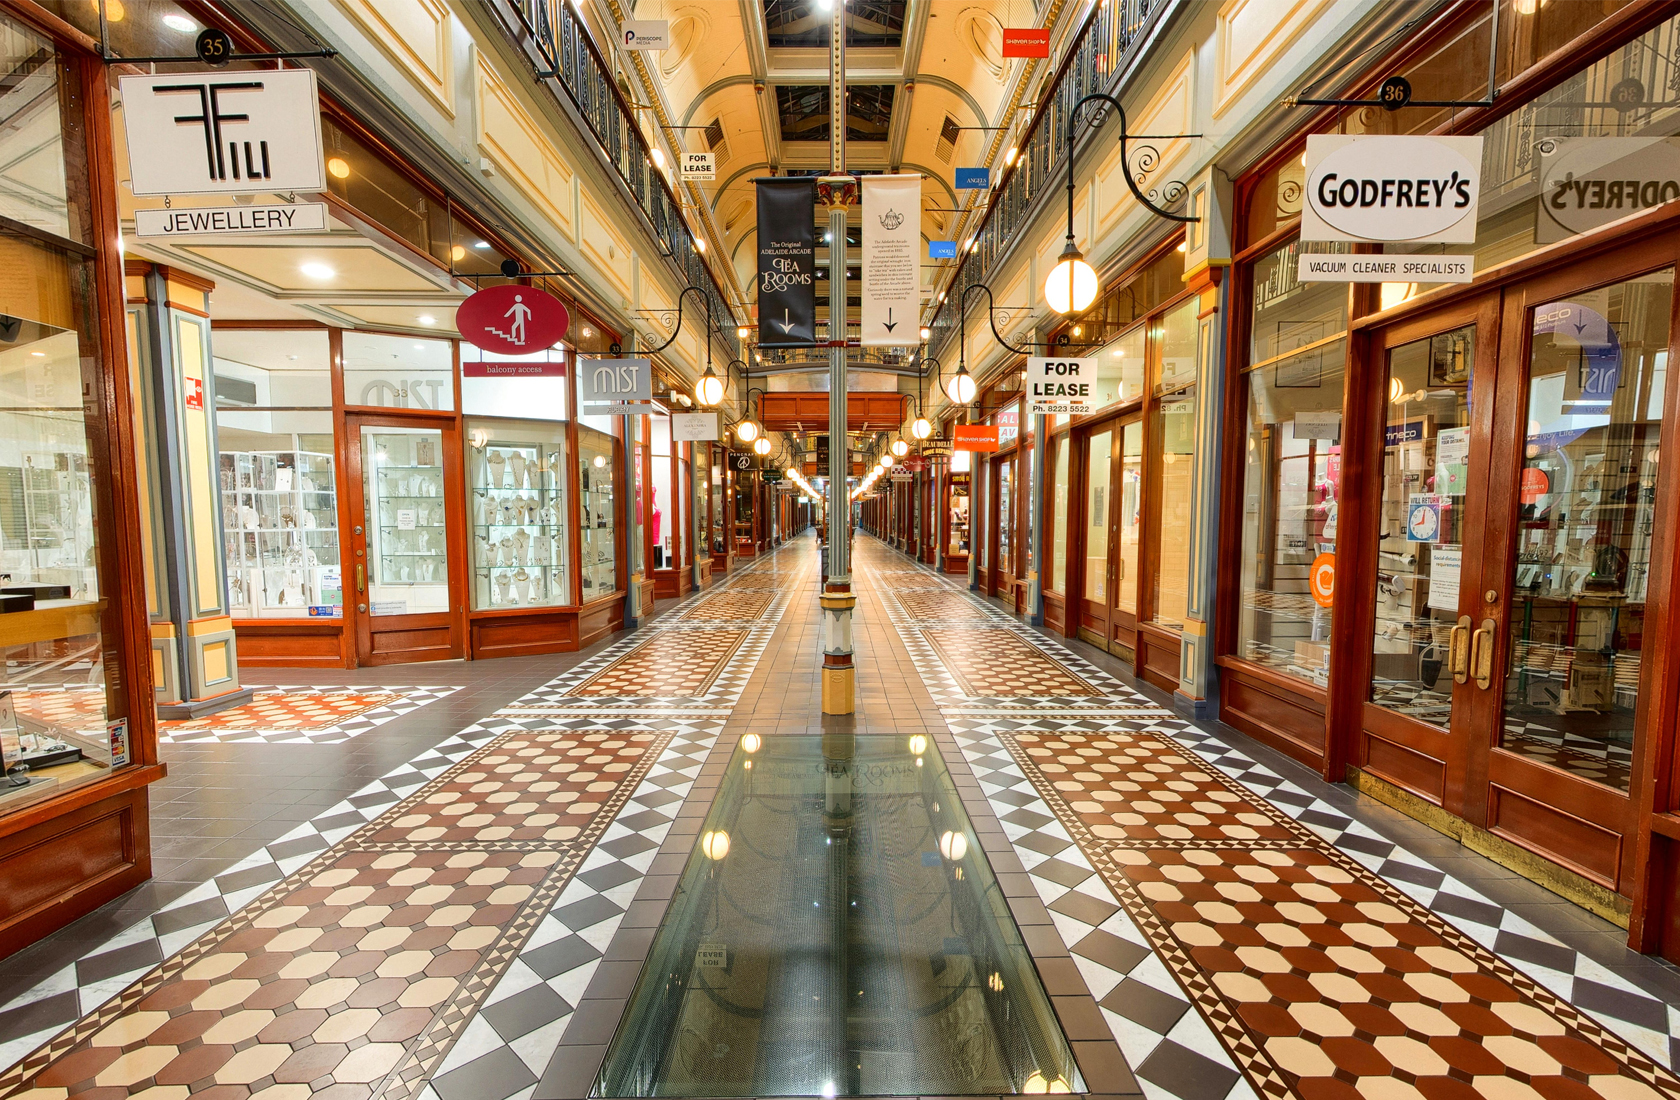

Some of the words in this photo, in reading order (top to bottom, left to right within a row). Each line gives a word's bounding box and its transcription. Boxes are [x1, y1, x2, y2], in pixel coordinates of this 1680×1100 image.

[203, 38, 223, 56] 35
[1385, 85, 1404, 101] 36
[1317, 170, 1471, 208] GODFREY'S
[163, 209, 296, 233] JEWELLERY
[781, 241, 802, 249] Original
[1309, 261, 1347, 273] VACUUM
[1352, 262, 1396, 274] CLEANER
[1402, 263, 1466, 275] SPECIALISTS
[761, 271, 812, 293] ROOMS
[486, 365, 516, 376] balcony
[518, 366, 542, 374] access
[1044, 362, 1080, 376] FOR
[593, 366, 639, 393] MIST
[393, 388, 408, 398] 33
[1033, 382, 1089, 397] LEASE
[1069, 405, 1090, 413] 5522
[1422, 496, 1440, 504] RETURN
